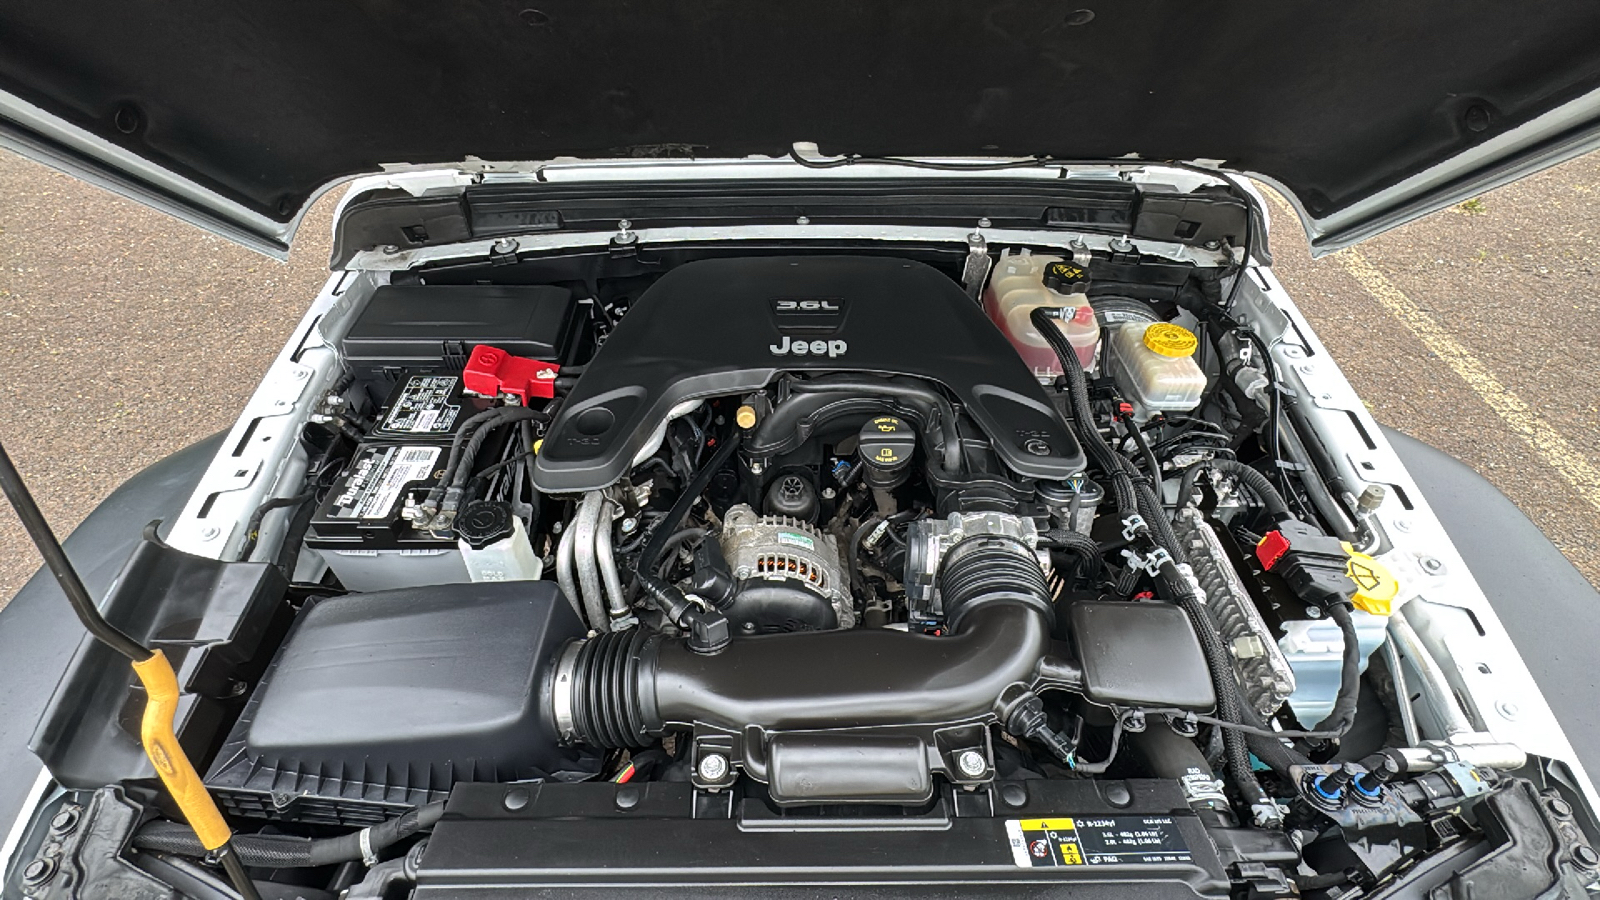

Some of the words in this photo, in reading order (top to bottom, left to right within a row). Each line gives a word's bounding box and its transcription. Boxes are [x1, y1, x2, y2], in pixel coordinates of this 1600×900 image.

[776, 300, 839, 310] 3.6L
[769, 336, 848, 358] Jeep
[338, 458, 375, 506] Duralast
